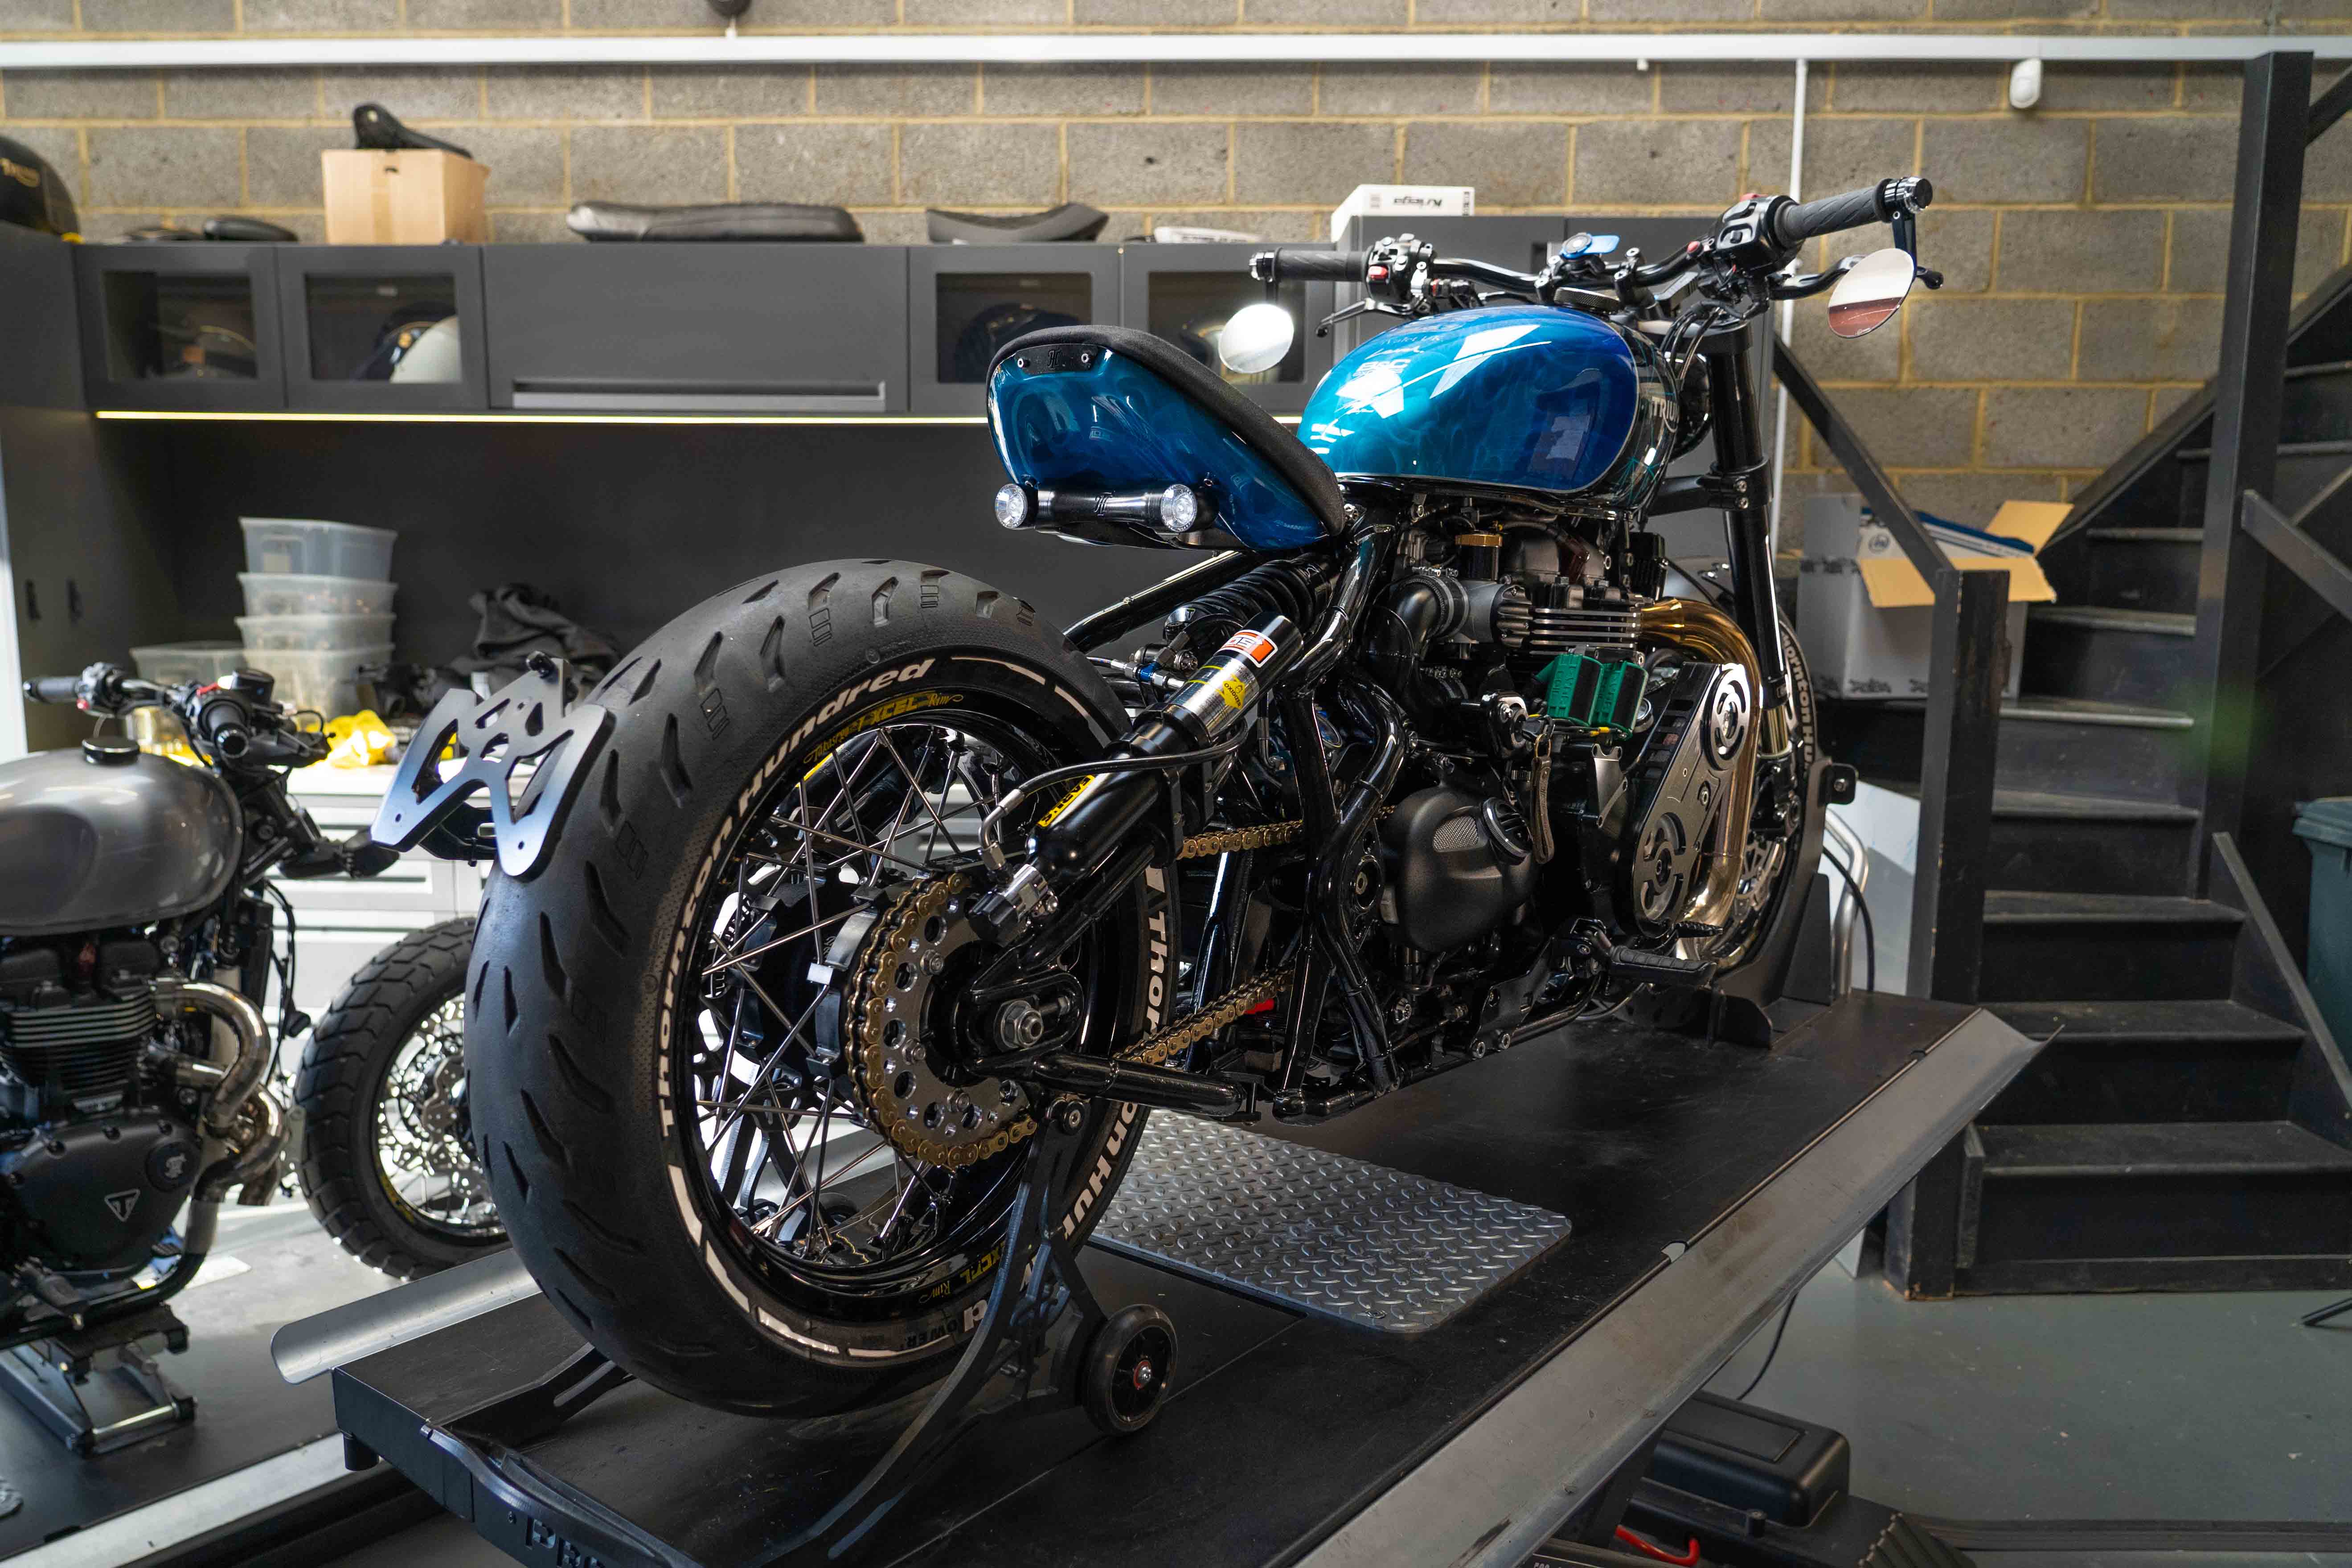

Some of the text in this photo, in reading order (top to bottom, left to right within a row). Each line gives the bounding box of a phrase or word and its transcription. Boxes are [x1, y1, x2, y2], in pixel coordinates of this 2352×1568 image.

[1224, 683, 1241, 708] OXIDIZER
[1782, 631, 1812, 723] hornton
[1041, 777, 1092, 823] EARL'S
[658, 658, 936, 1138] Thornton Hundred
[959, 1241, 1005, 1284] XCEL
